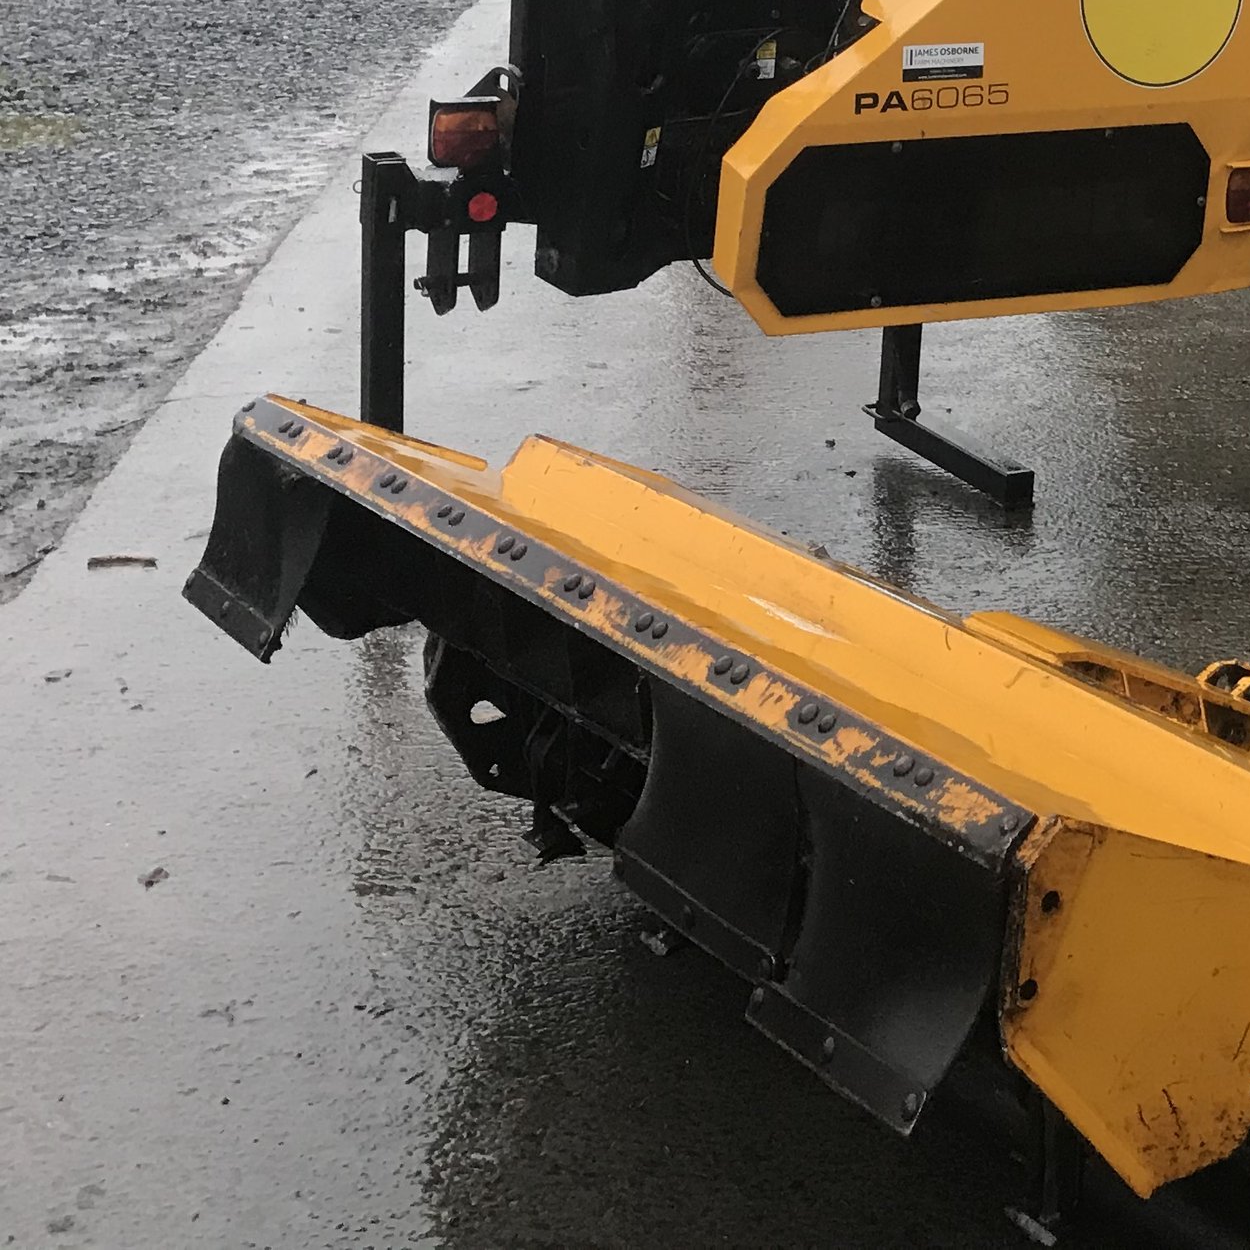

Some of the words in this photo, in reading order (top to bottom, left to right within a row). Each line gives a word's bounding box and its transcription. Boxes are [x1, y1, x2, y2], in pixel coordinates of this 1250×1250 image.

[914, 48, 938, 57] JAMES
[940, 46, 979, 56] OSBORNE
[854, 83, 1009, 115] PA6065
